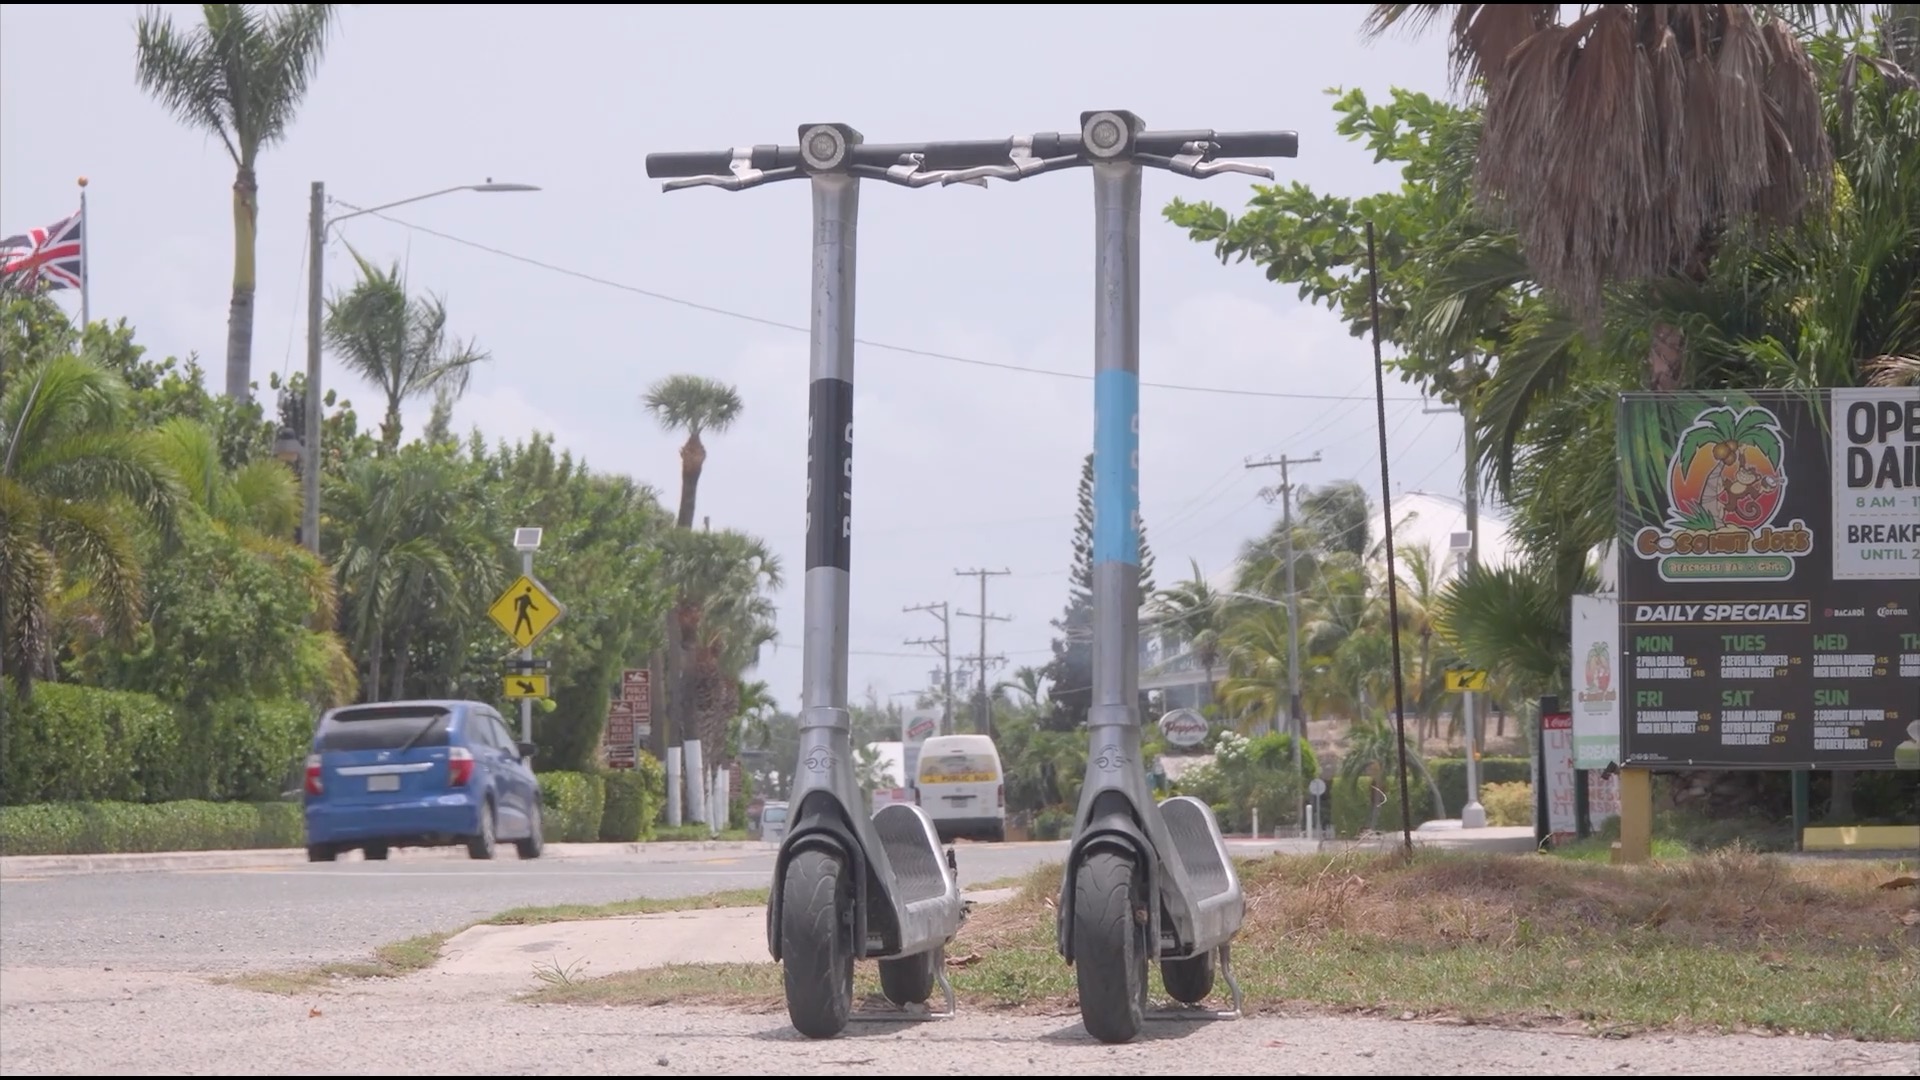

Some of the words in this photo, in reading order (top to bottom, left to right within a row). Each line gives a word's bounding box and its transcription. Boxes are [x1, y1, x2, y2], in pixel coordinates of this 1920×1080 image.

[1855, 496, 1866, 508] 8
[1870, 496, 1896, 508] AM
[1637, 529, 1750, 555] COCONUT
[1752, 522, 1811, 553] JOE'S
[1860, 548, 1907, 560] UNTIL
[1757, 561, 1786, 572] GRILL
[1635, 605, 1701, 622] DAILY
[1702, 603, 1807, 621] SPECIALS
[1877, 606, 1908, 618] Corona
[1636, 635, 1673, 652] MON
[1720, 634, 1766, 652] TUES
[1813, 633, 1848, 651] WED
[1636, 655, 1642, 667] 2
[1720, 655, 1726, 666] 2
[1726, 655, 1746, 667] SEVEN
[1760, 655, 1788, 666] SUNSETS
[1813, 654, 1819, 666] 2
[1636, 690, 1663, 707] FRI
[1721, 689, 1754, 707] SAT
[1813, 689, 1849, 706] SUN
[1637, 711, 1642, 722] 2
[1721, 710, 1726, 721] 2
[1744, 710, 1757, 721] AND
[1813, 709, 1819, 721] 2
[974, 772, 990, 782] BUS
